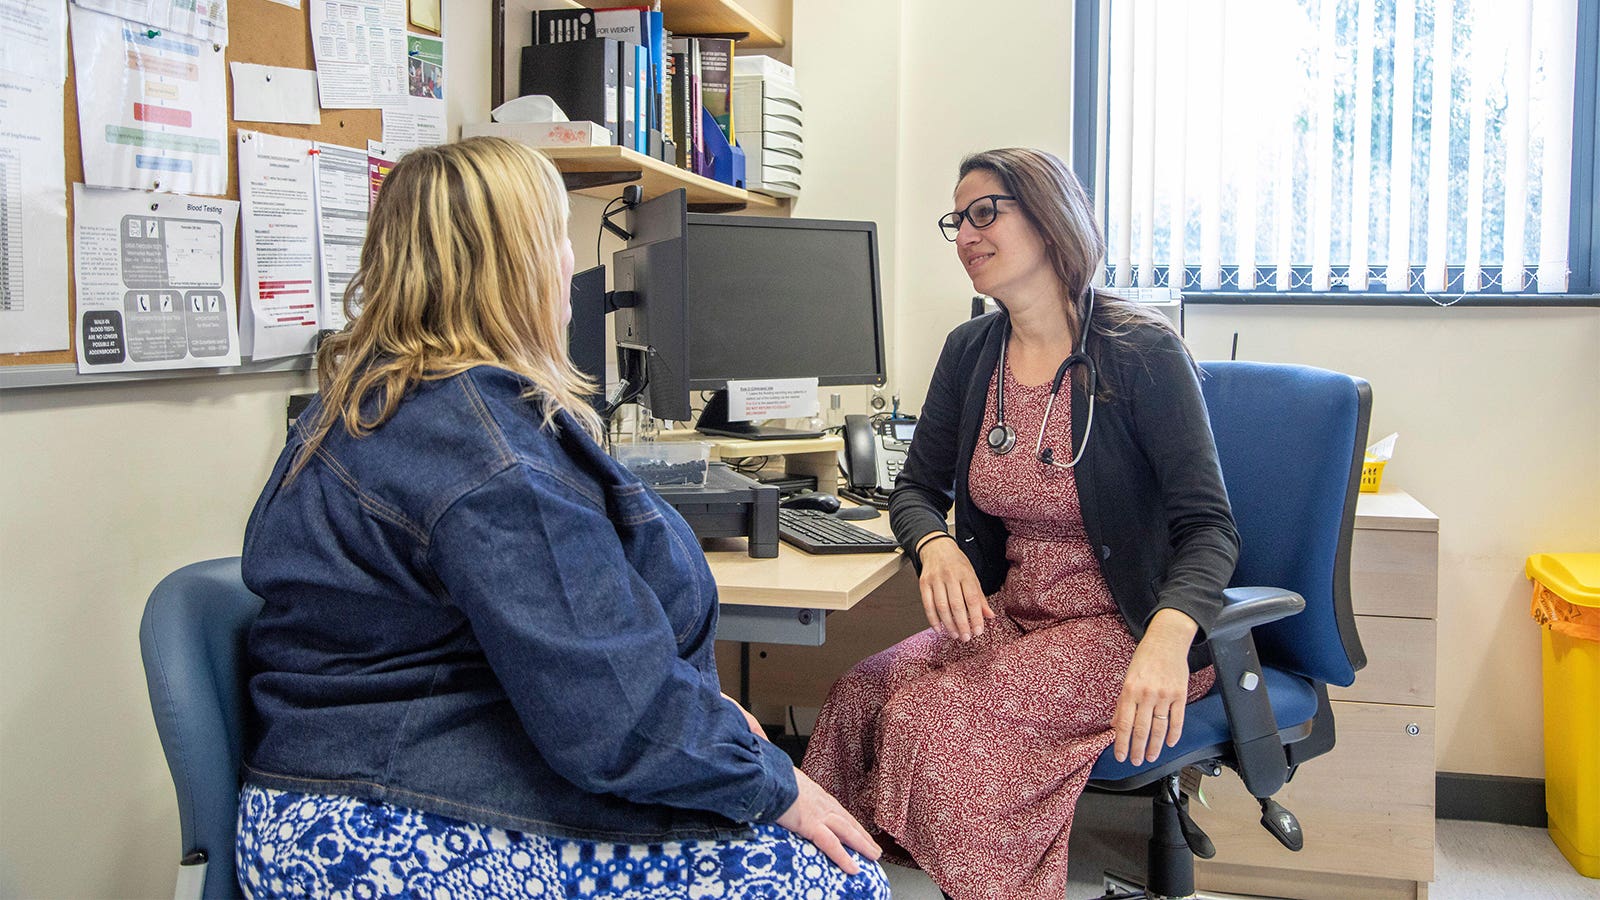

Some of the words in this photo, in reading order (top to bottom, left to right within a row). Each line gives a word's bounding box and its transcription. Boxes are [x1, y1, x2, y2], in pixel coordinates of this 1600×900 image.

[610, 26, 635, 34] WEIGHT
[187, 204, 202, 212] Blood
[203, 205, 223, 214] Testing
